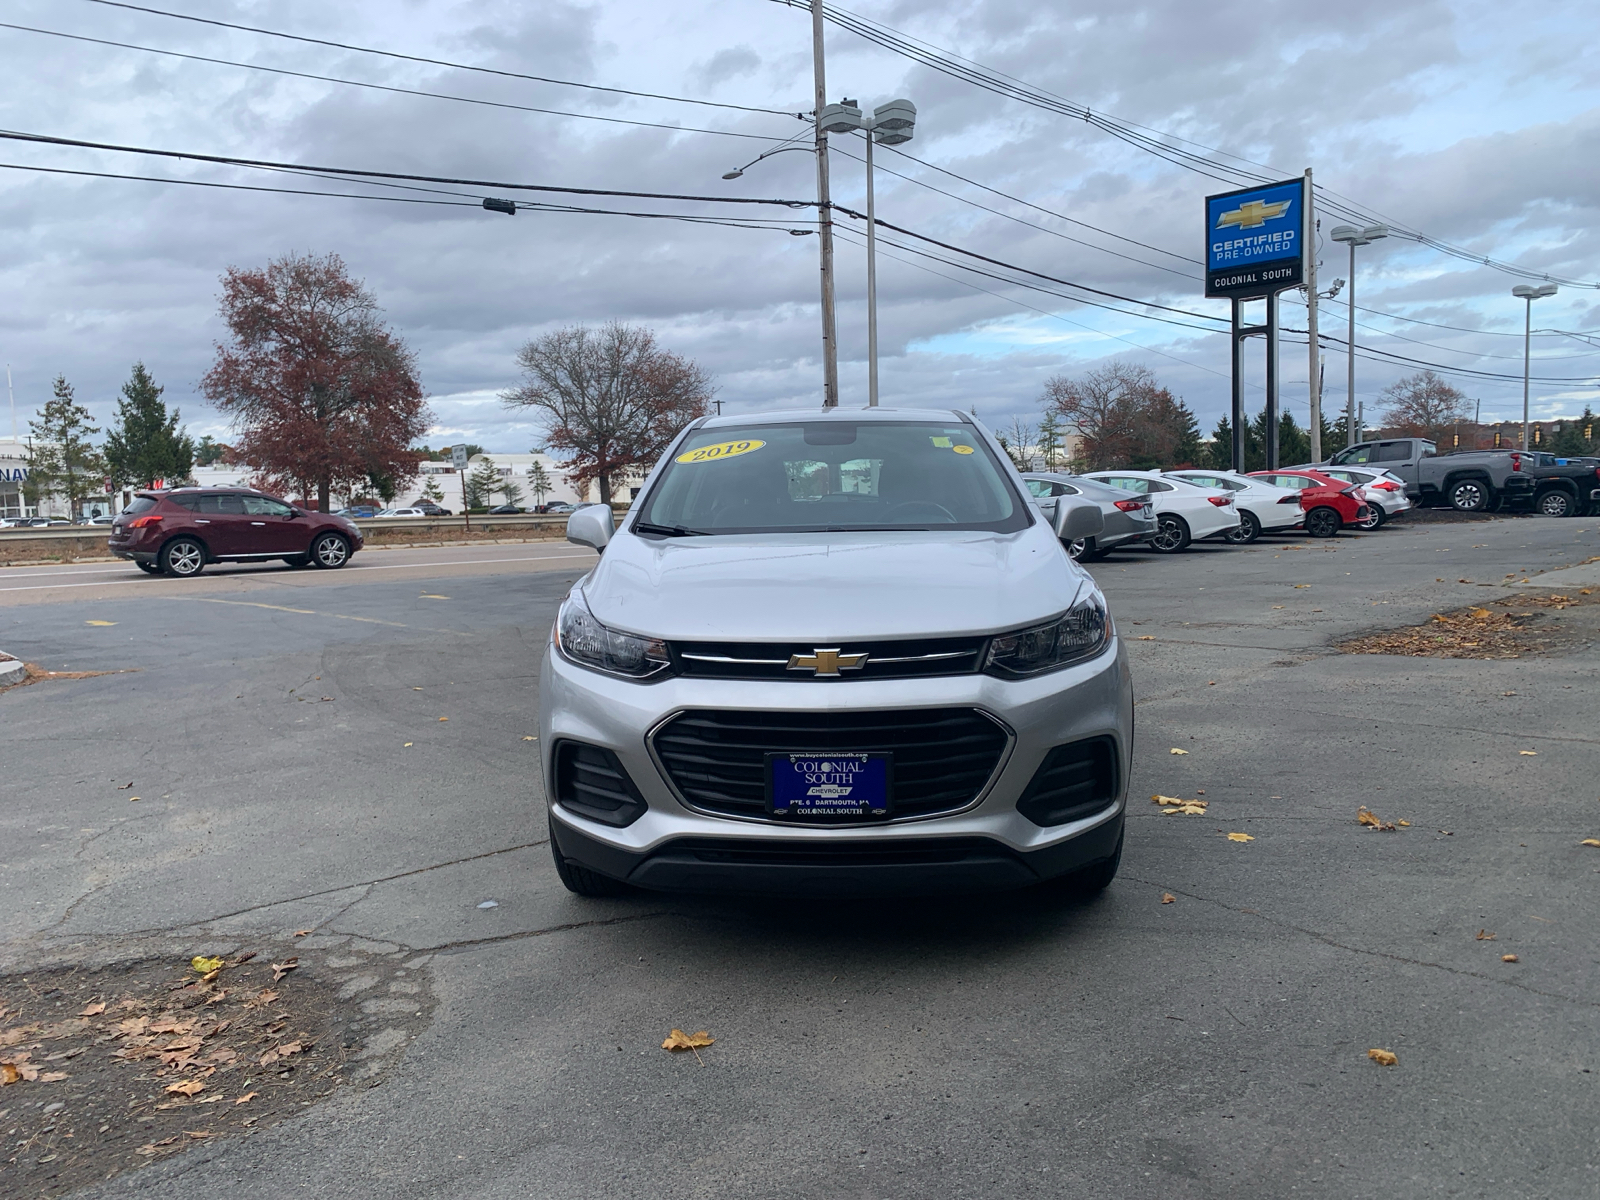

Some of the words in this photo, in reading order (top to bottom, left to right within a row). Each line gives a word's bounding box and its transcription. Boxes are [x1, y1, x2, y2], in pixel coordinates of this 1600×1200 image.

[1213, 230, 1295, 253] CERTIFIED
[1216, 241, 1291, 261] PRE-OWNED
[1215, 273, 1258, 288] COLONIAL
[1262, 268, 1292, 280] SOUTH
[692, 441, 751, 462] 2019
[794, 762, 864, 773] COLONIAL
[805, 773, 853, 784] SOUTH
